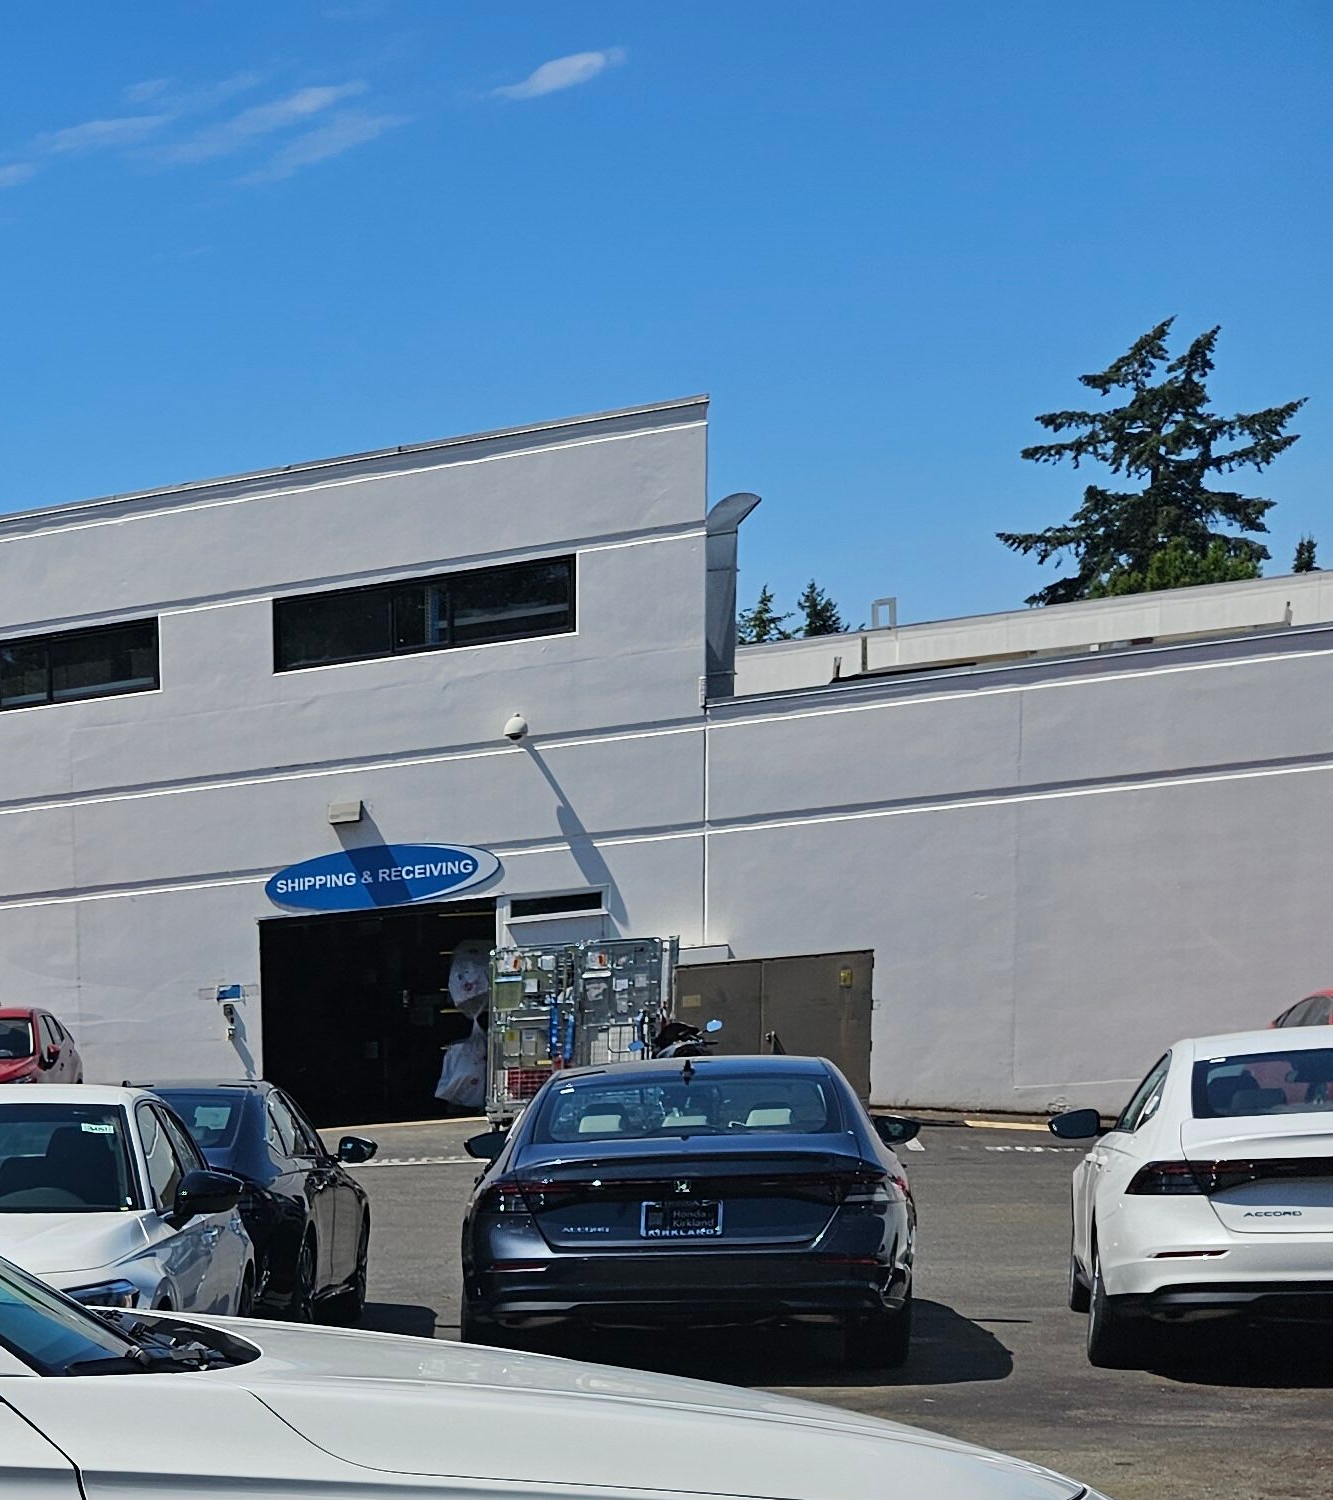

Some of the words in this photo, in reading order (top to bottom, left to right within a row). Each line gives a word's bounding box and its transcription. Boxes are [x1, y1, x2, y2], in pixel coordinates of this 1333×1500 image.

[276, 872, 357, 894] SHIPPING
[361, 870, 374, 885] &
[378, 859, 474, 883] RECEIVING
[672, 1218, 715, 1227] Kirkland
